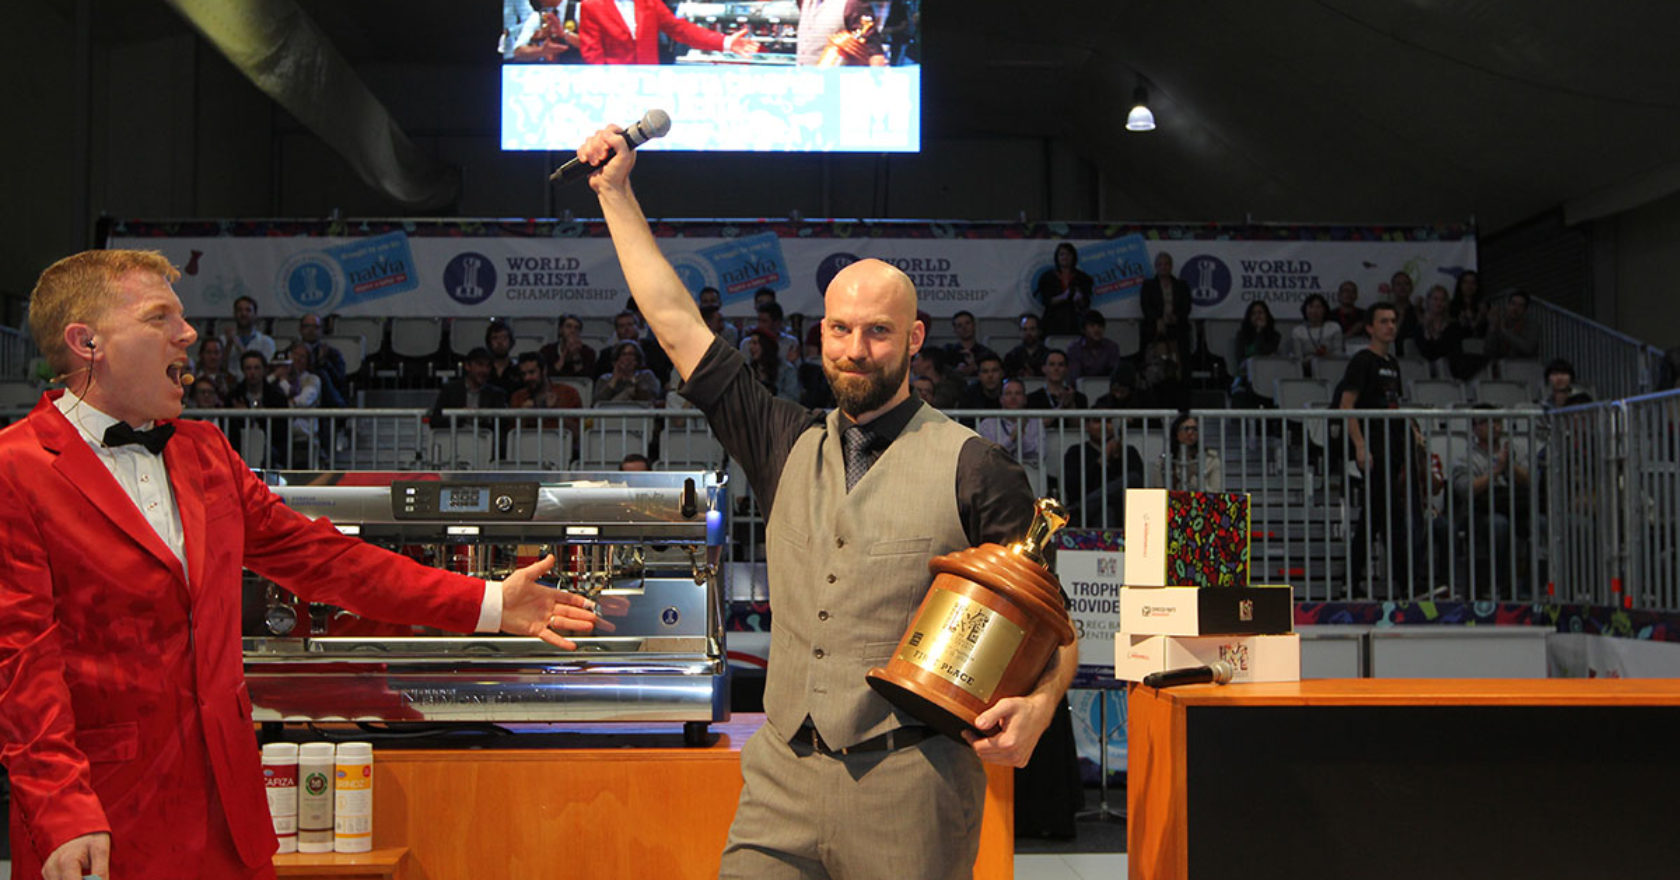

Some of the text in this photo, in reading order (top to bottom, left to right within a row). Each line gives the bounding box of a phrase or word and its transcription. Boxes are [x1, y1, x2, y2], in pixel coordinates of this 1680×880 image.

[506, 257, 580, 270] WORLD
[1240, 259, 1312, 273] WORLD
[506, 273, 589, 286] BARISTA
[908, 274, 960, 287] RISTA
[1241, 275, 1321, 289] BARISTA
[506, 288, 618, 300] CHAMPIONSHIP
[917, 289, 989, 301] PIONSHIP
[1072, 582, 1121, 597] TROPH
[1070, 598, 1120, 613] ROVIDE
[940, 662, 975, 686] PLACE
